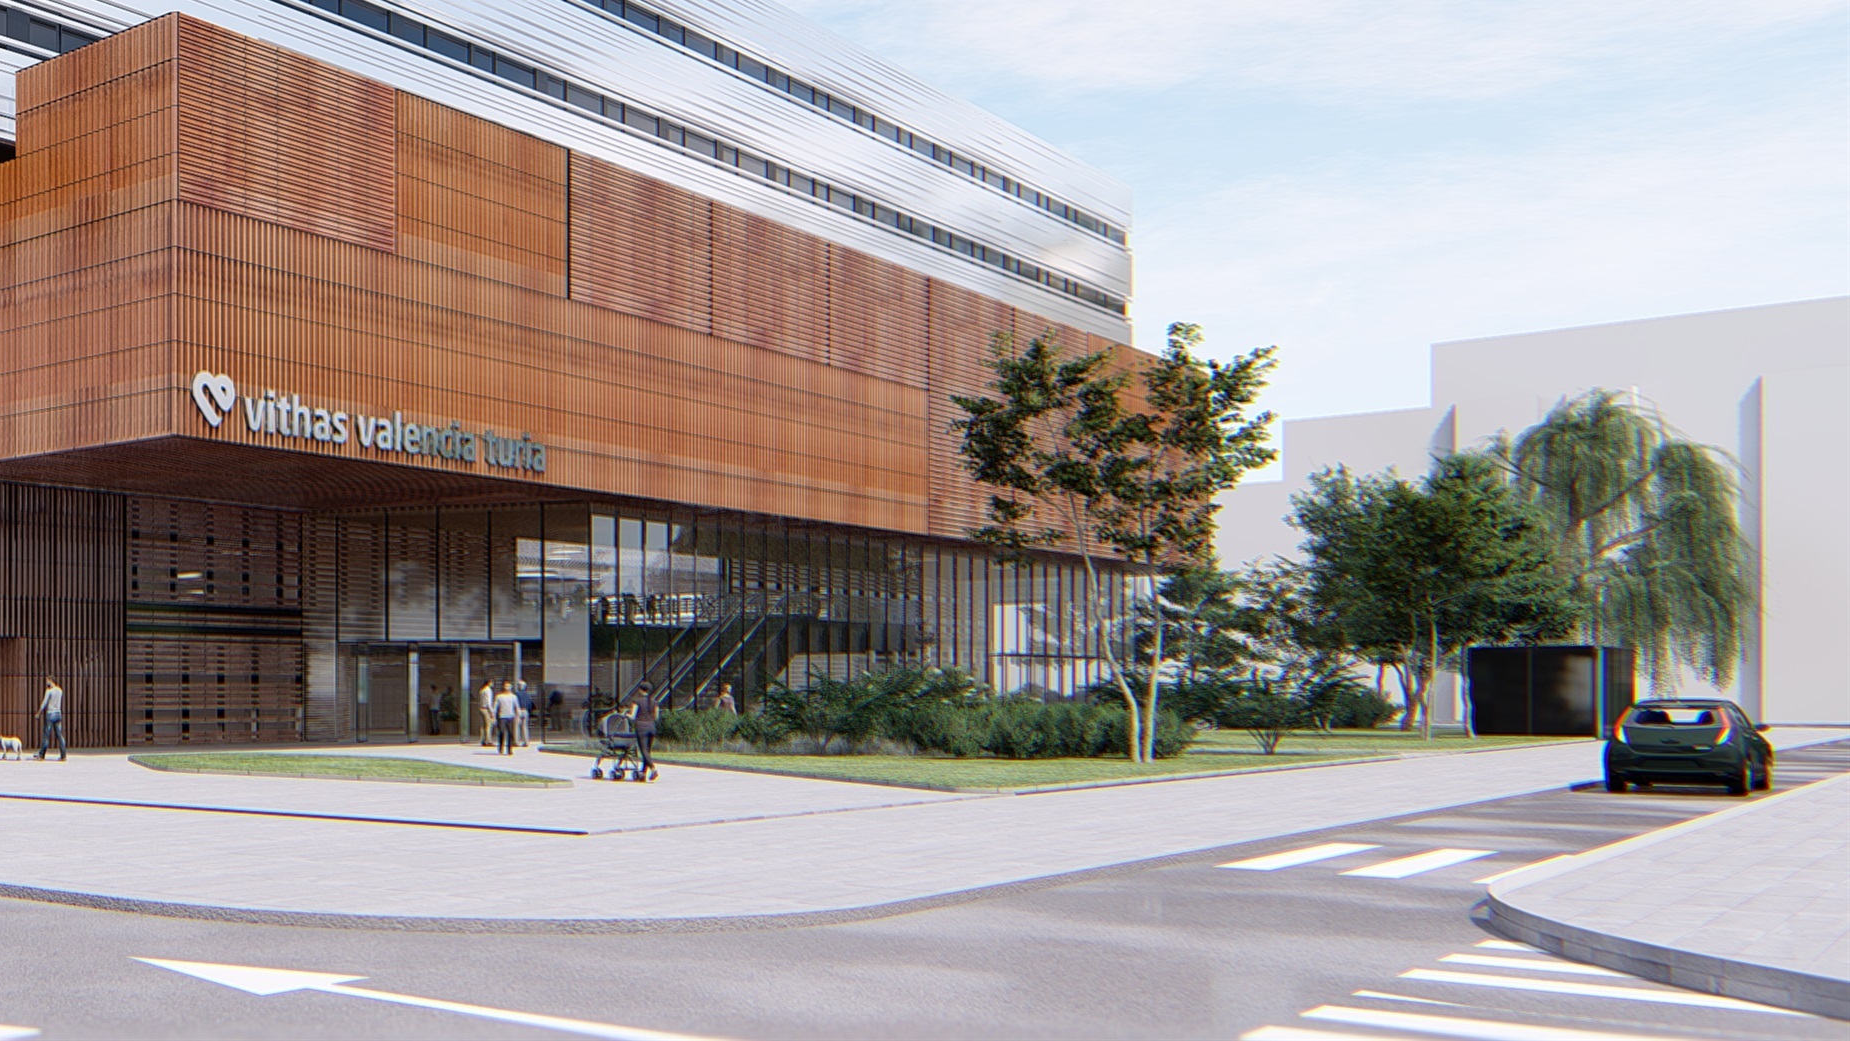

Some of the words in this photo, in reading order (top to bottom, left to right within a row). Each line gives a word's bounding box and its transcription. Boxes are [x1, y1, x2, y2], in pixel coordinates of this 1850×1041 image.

[242, 389, 348, 445] vithas
[355, 410, 477, 463] valencia
[483, 429, 547, 473] turia
